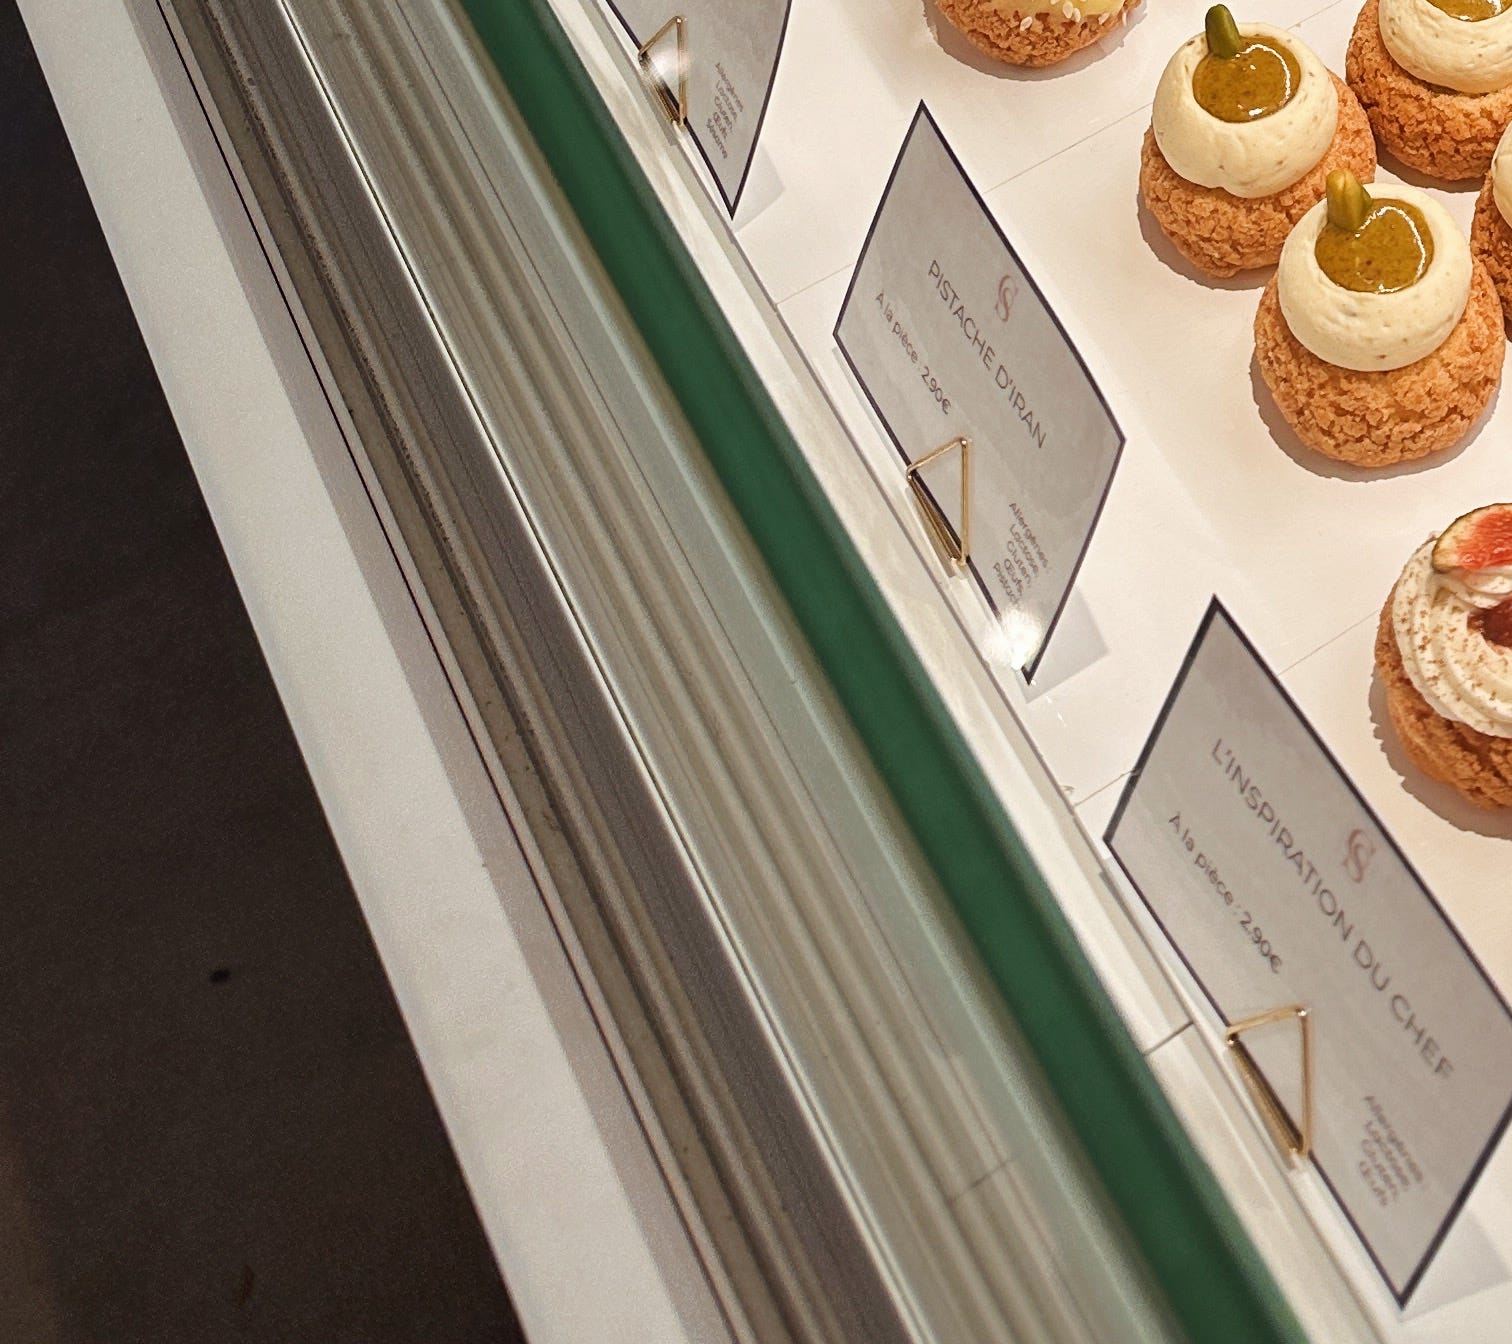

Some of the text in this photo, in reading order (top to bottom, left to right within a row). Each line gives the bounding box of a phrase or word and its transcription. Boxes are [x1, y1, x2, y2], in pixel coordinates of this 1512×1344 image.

[883, 303, 893, 323] la
[921, 366, 951, 415] 2.90€
[928, 260, 1046, 449] PISTACHE D'IRAN
[1181, 828, 1195, 852] la
[1239, 911, 1282, 974] 2.90€
[1212, 739, 1453, 1078] L'INSPIRATION DU CHEF
